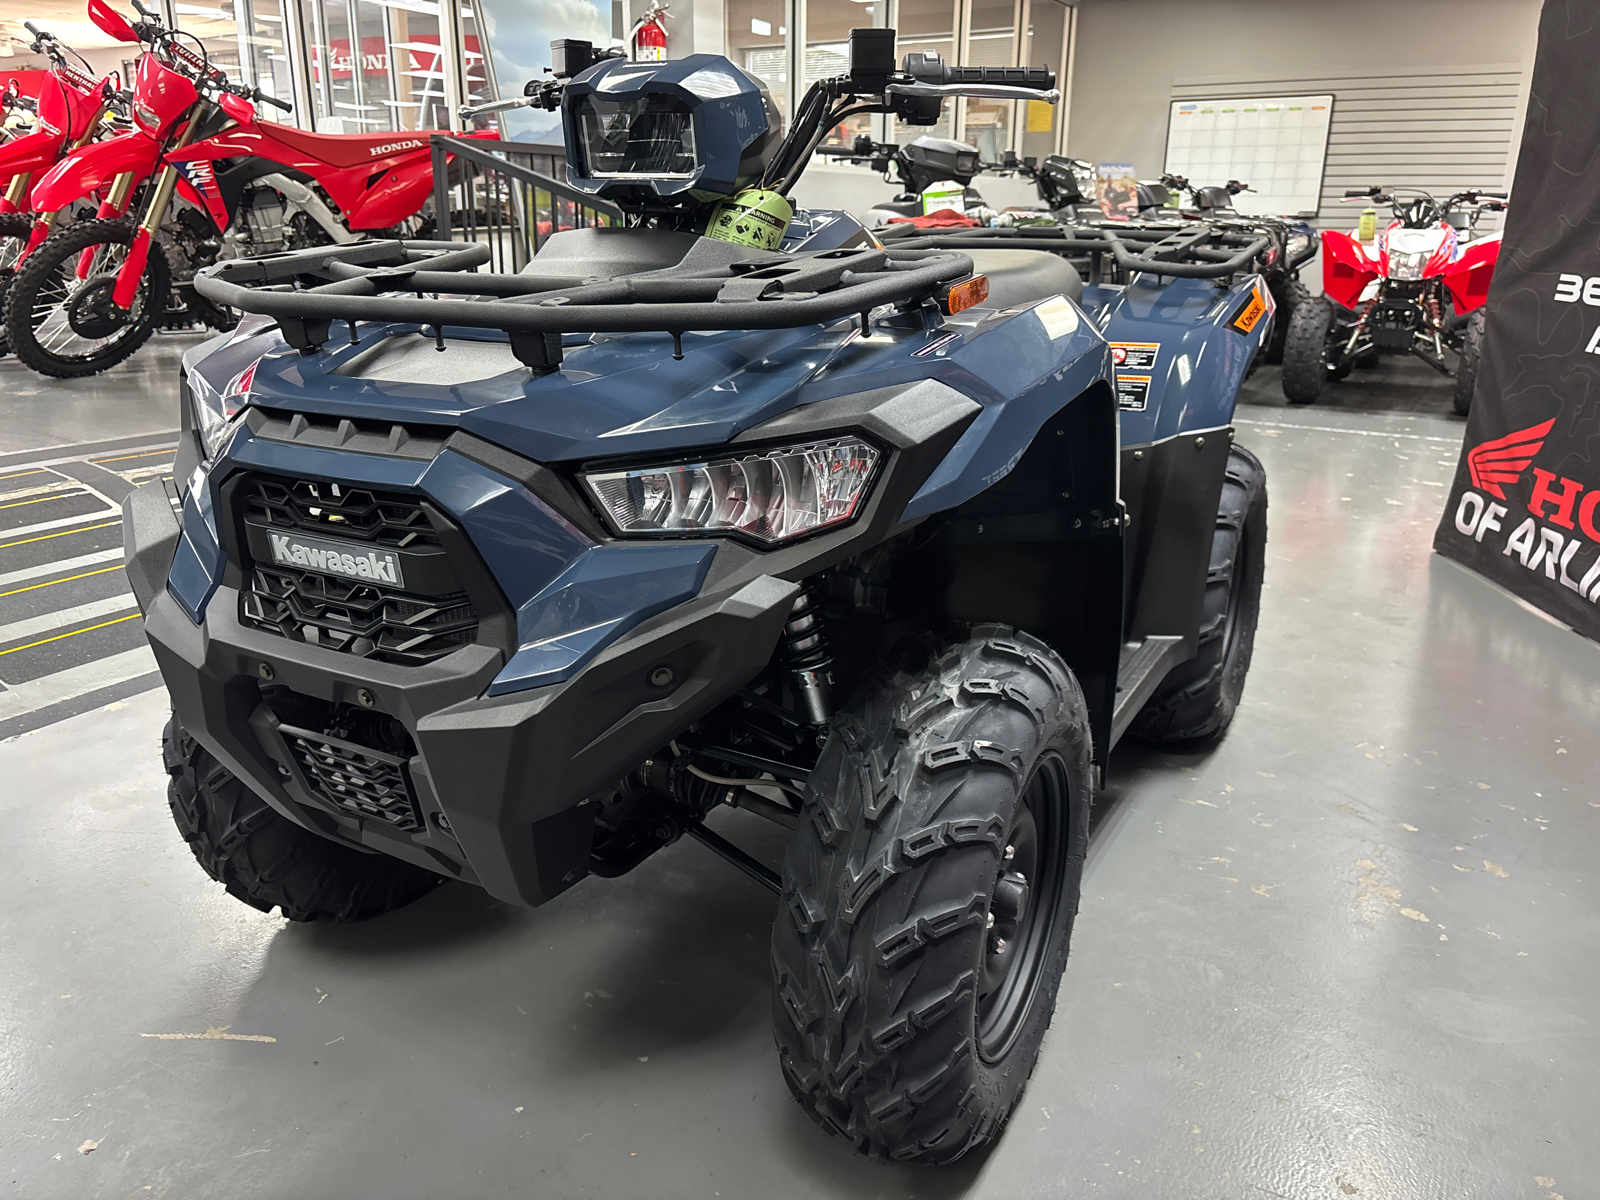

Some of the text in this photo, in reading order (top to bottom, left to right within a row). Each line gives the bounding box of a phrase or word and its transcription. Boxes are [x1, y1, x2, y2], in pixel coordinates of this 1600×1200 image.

[369, 139, 424, 156] HONDA
[185, 160, 214, 187] CRF
[1239, 300, 1262, 330] Kawasaki
[1454, 491, 1508, 543] OF
[271, 534, 398, 583] Kawasaki
